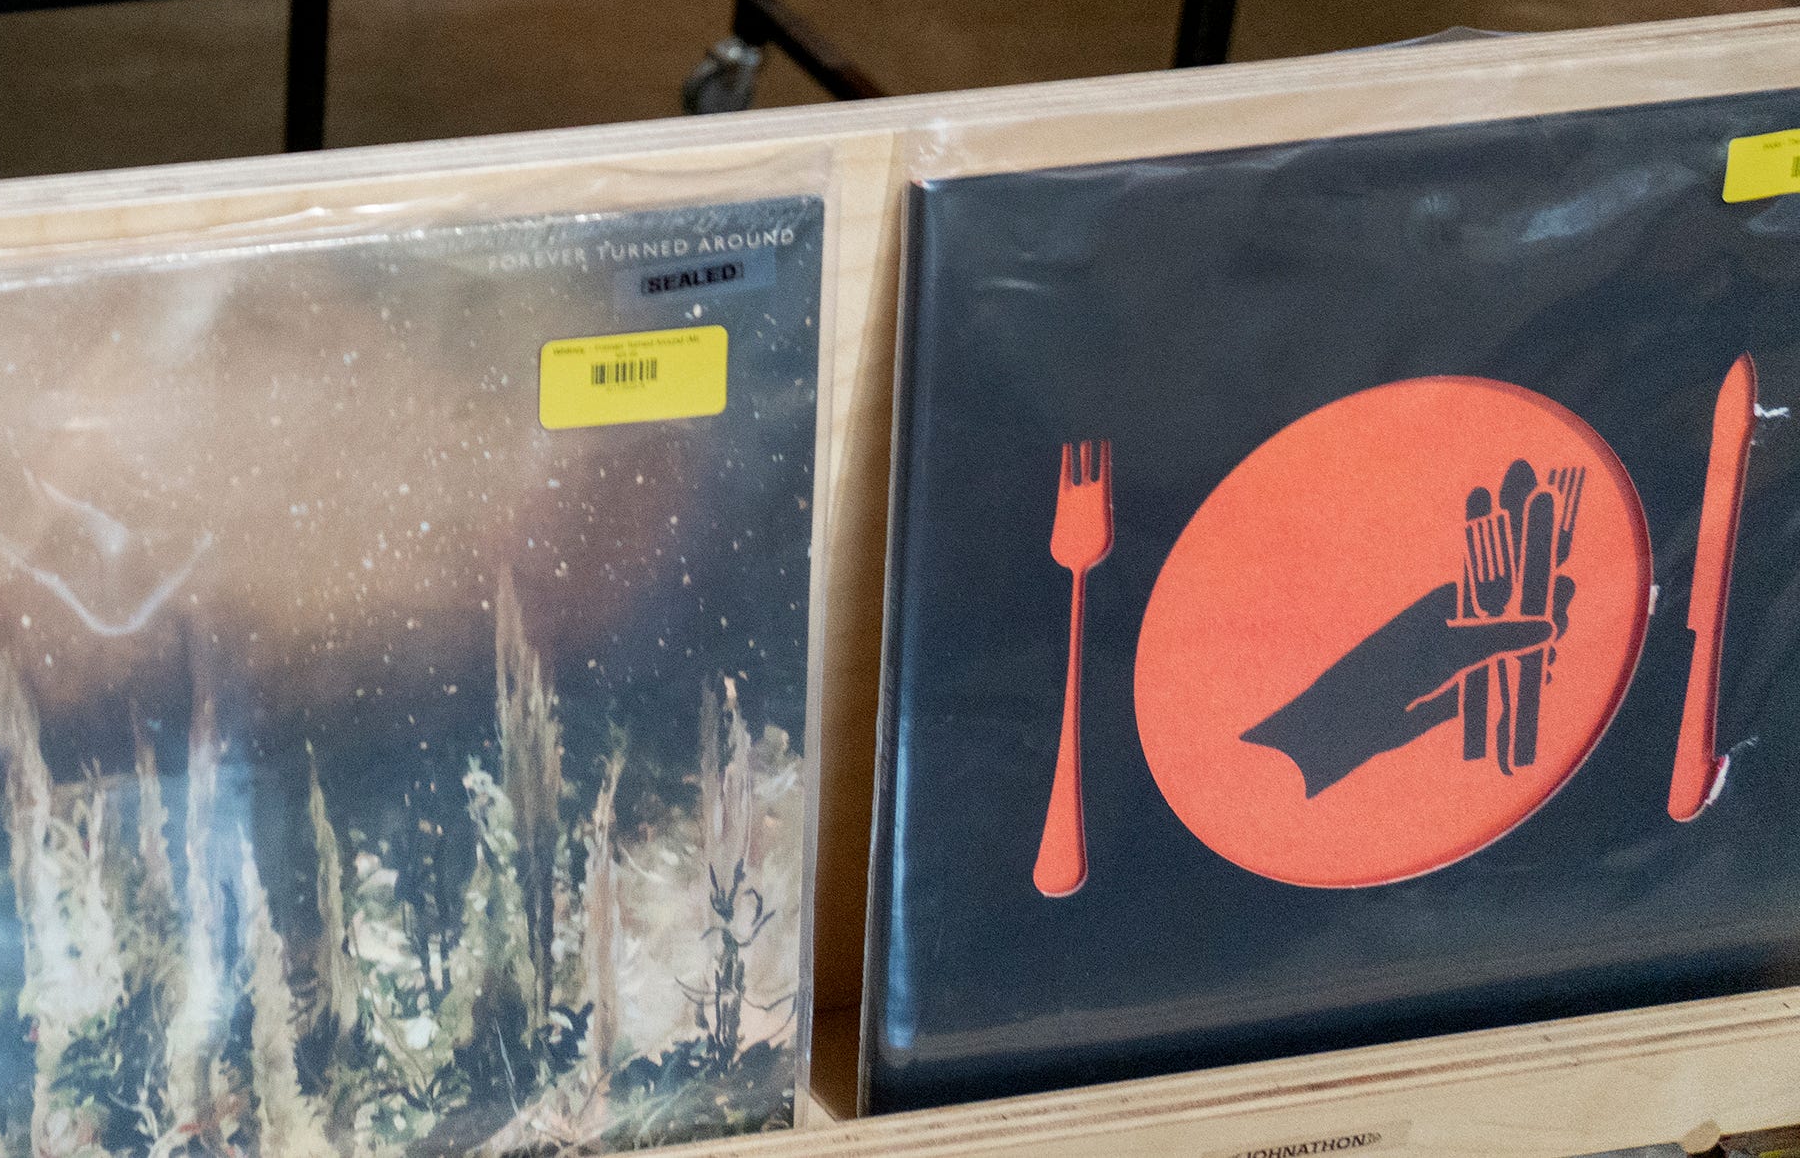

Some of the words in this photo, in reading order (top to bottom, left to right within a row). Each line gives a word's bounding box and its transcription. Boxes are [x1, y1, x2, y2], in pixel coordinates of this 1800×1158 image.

[487, 247, 587, 272] FOREVER
[599, 239, 689, 262] TURNED
[699, 228, 796, 253] AROUND
[646, 262, 739, 294] SEALED
